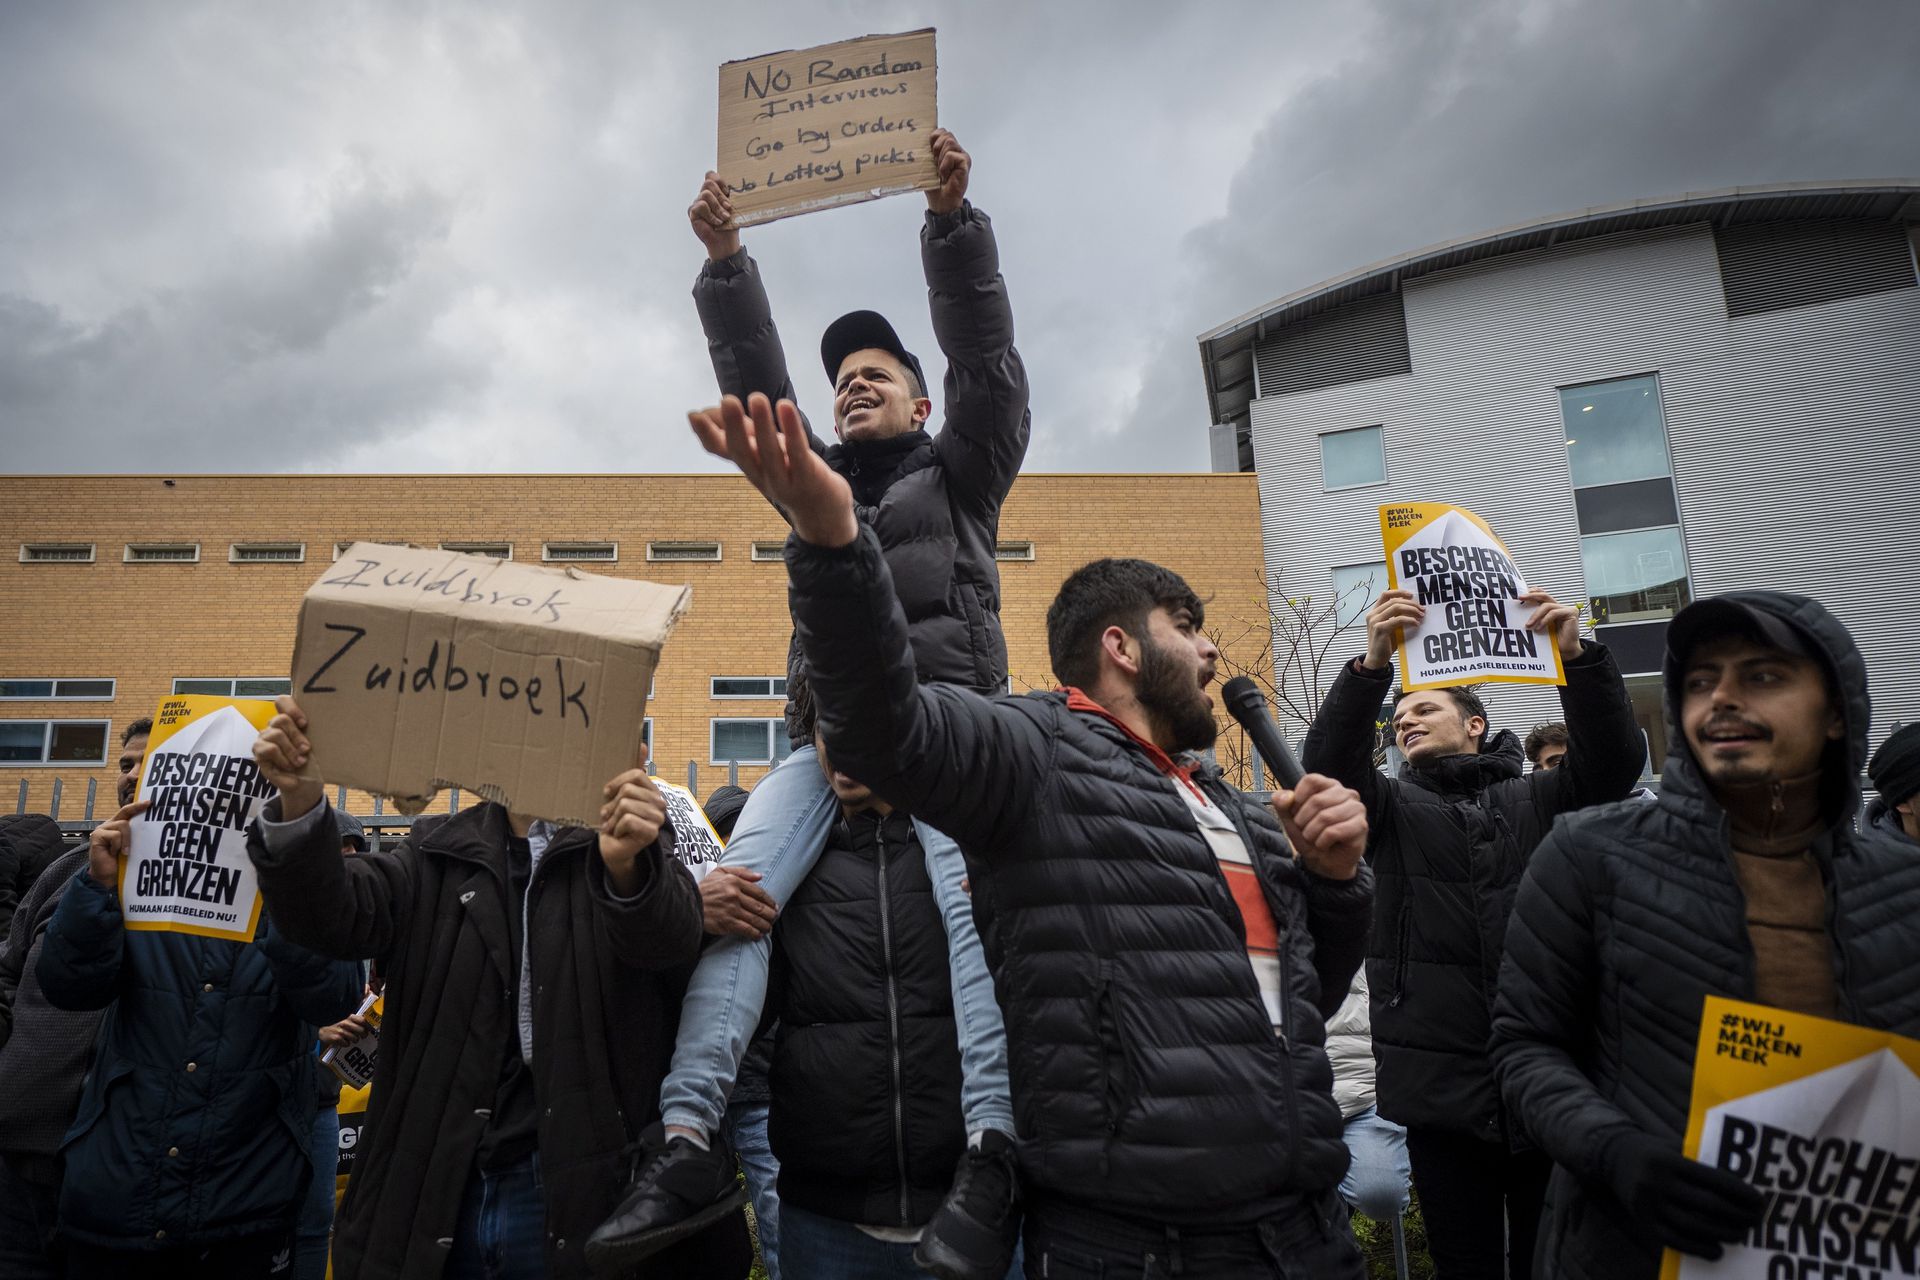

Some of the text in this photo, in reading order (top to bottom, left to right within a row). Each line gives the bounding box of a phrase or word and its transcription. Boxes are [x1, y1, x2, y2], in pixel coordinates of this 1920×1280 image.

[808, 52, 922, 84] Random
[753, 82, 908, 121] Interviews
[746, 116, 917, 157] Go by Orders
[728, 147, 915, 196] No Lottery picks
[1387, 508, 1414, 516] #WIJ
[1388, 513, 1422, 522] MAKEN
[1389, 520, 1411, 528] PLEK
[323, 559, 571, 623] Zuidbrok
[1416, 571, 1525, 606] MENSEN
[1445, 599, 1508, 631] GEEN
[1423, 628, 1538, 663] GRENZEN
[302, 623, 590, 728] Zuidbroek
[1420, 665, 1468, 677] HUMAAN
[1469, 662, 1527, 671] ASIELBELEID
[161, 709, 191, 717] MAKEN
[163, 701, 187, 709] #WIJ
[158, 717, 177, 725] PLEK
[159, 822, 223, 864] GEEN
[136, 859, 241, 906] GRENZEN
[129, 904, 161, 913] HUMAAN
[216, 912, 237, 922] NU!
[1721, 1013, 1785, 1037] #WIJ
[1717, 1043, 1767, 1066] PLEK
[1719, 1028, 1802, 1057] MAKEN
